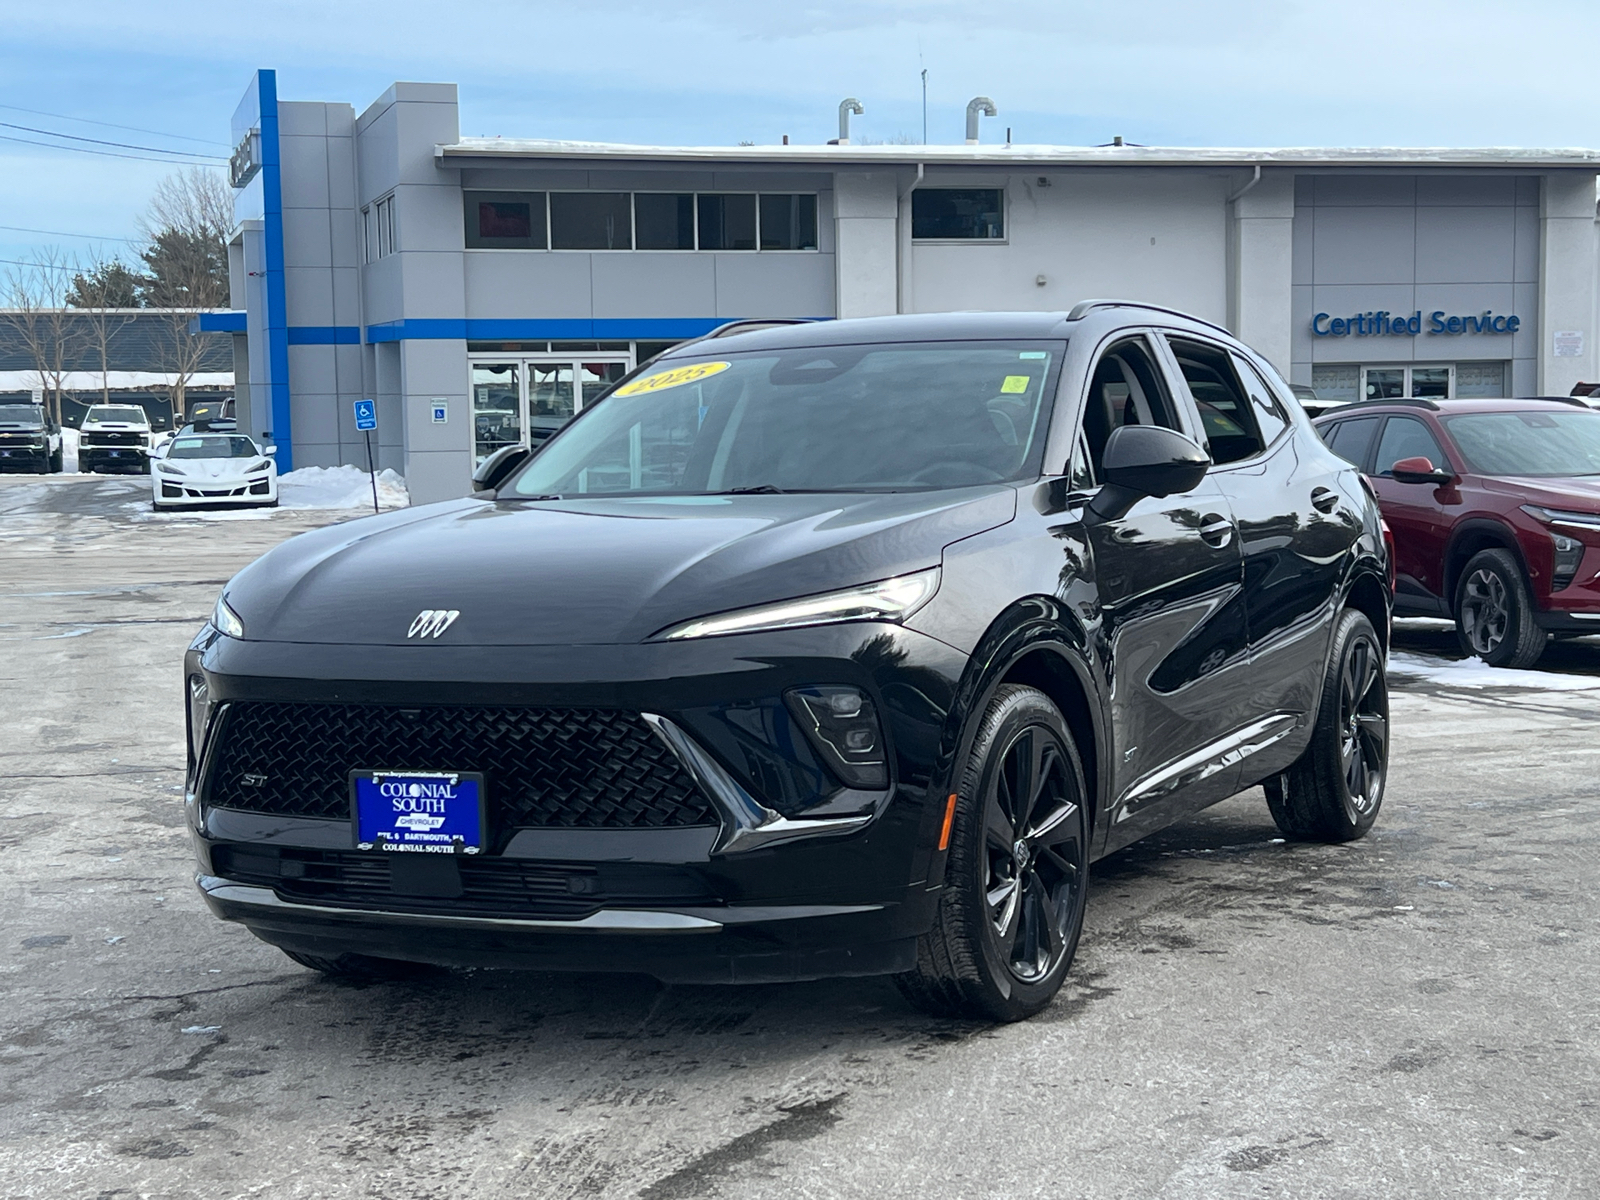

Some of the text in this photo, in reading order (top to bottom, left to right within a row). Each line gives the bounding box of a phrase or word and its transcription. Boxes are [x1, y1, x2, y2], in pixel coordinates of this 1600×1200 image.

[1312, 310, 1521, 336] Certified Service
[628, 364, 715, 395] 2025
[241, 773, 269, 788] ST
[380, 783, 457, 798] COLONIAL
[392, 798, 446, 813] SOUTH
[400, 817, 440, 826] CHEVROLET
[382, 843, 455, 854] COLONIAL SOUTH
